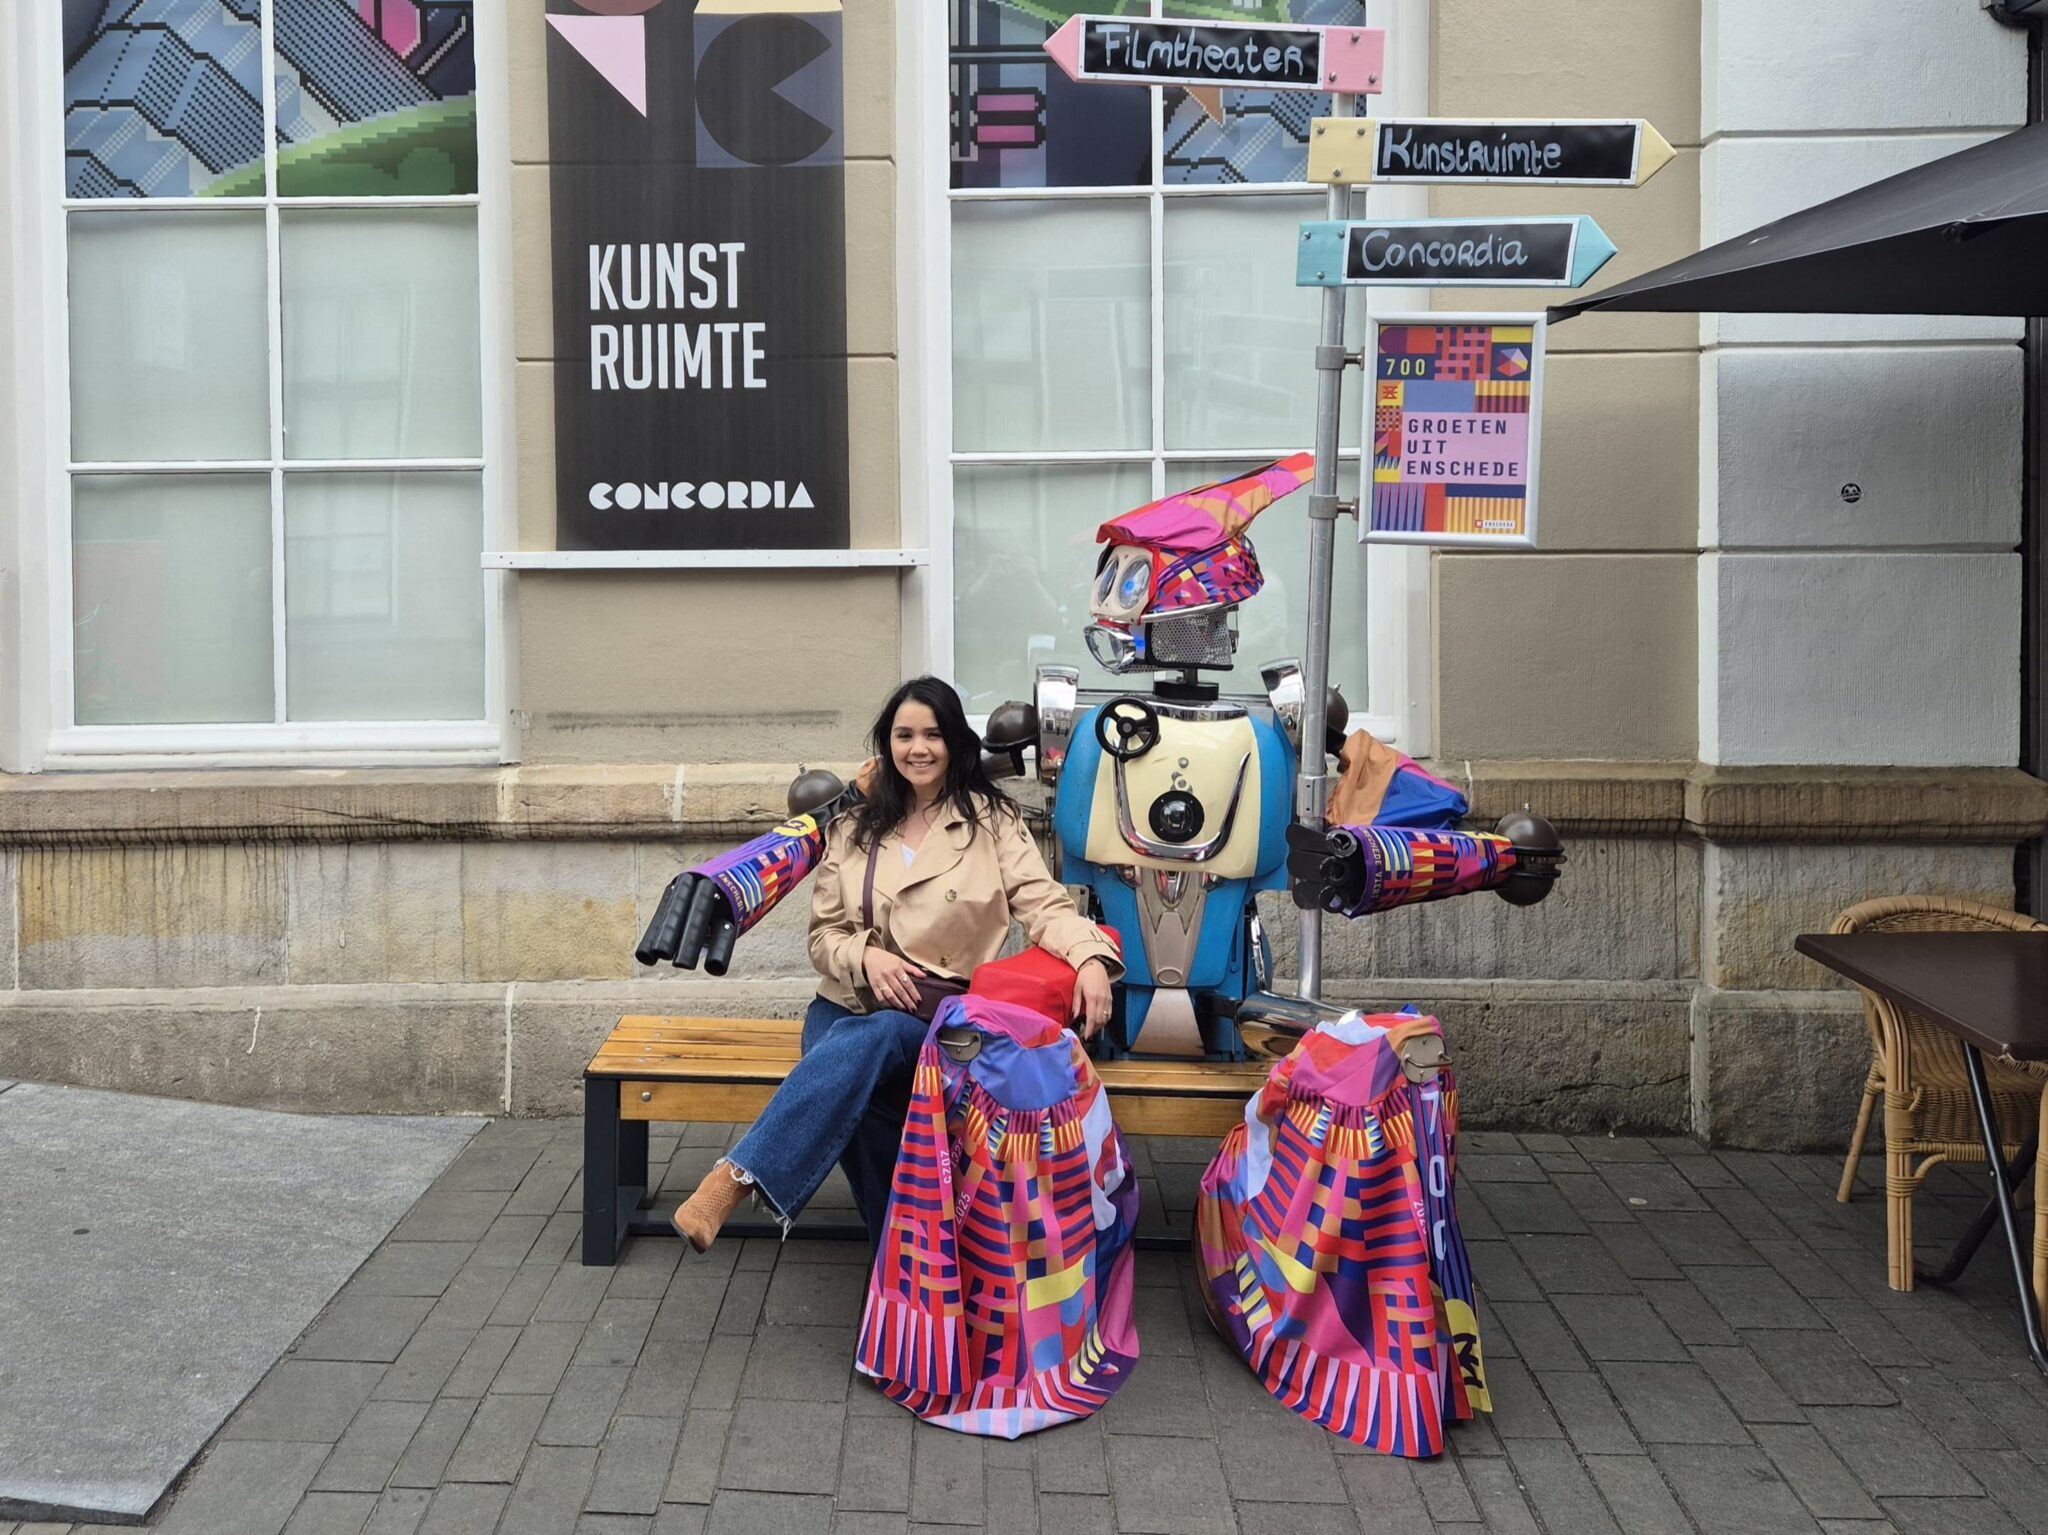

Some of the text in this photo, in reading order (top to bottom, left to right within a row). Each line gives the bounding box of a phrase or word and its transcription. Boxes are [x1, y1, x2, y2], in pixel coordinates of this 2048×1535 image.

[589, 242, 746, 311] KUNST
[591, 322, 767, 391] RUIMTE
[1386, 358, 1426, 376] 700
[1408, 418, 1507, 435] GROETEN
[1407, 439, 1447, 455] UIT
[1407, 460, 1519, 477] ENSCHEDE
[588, 481, 815, 510] CONCORDIA
